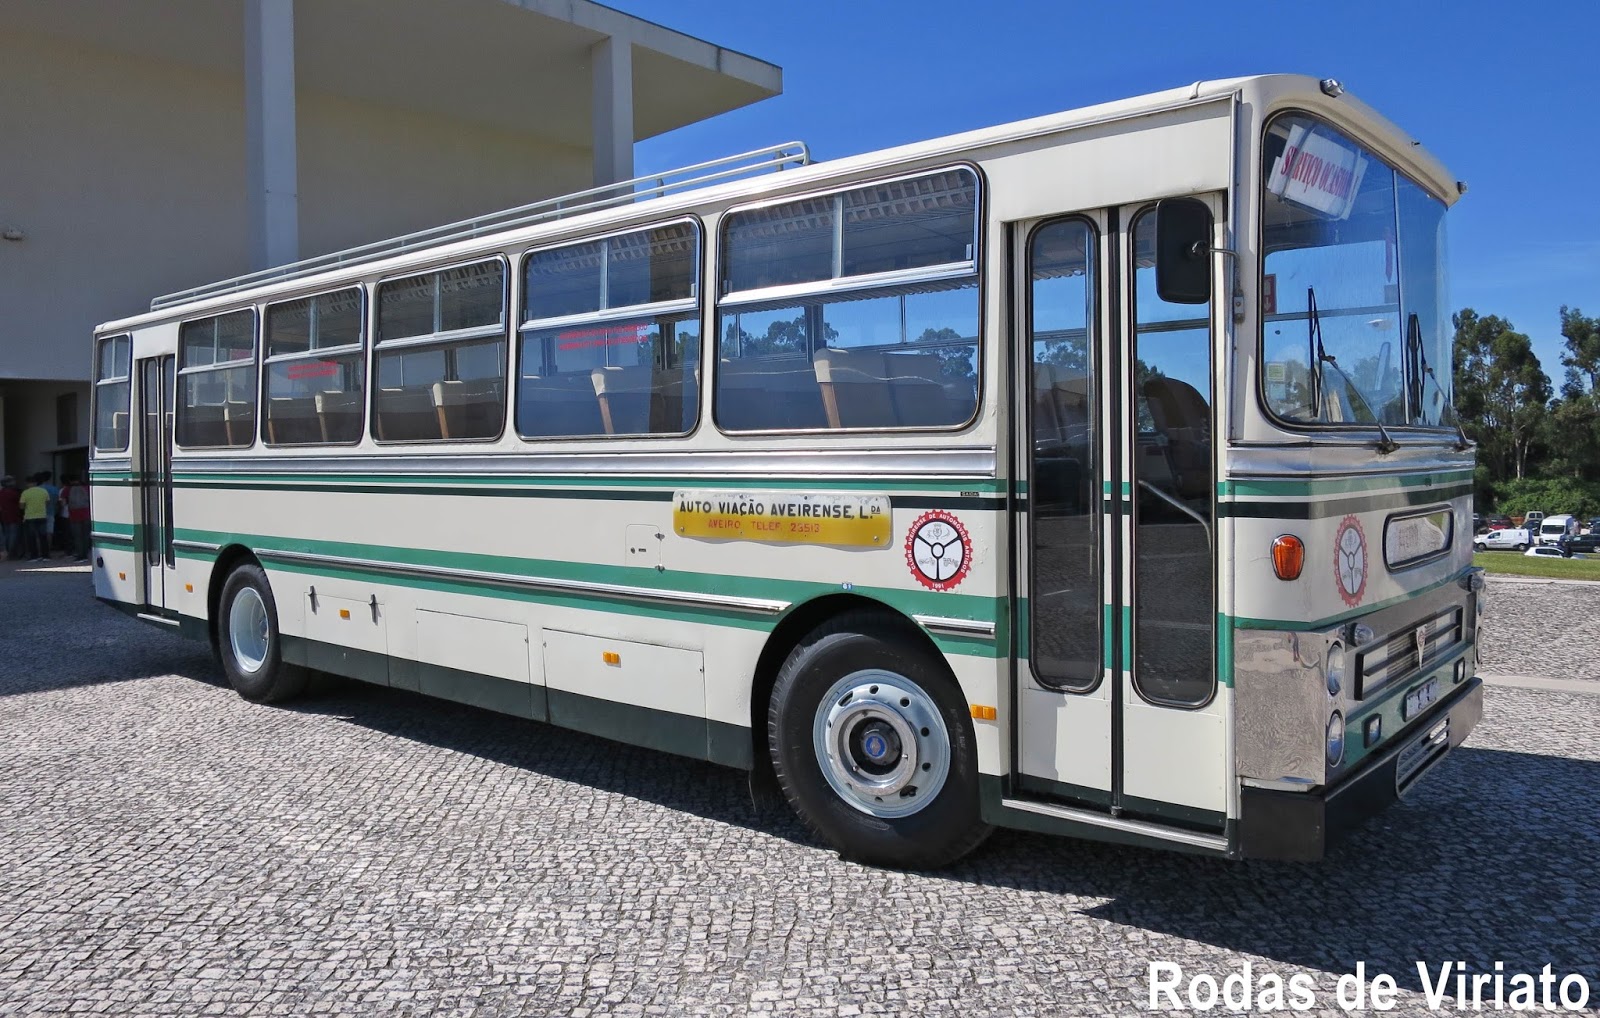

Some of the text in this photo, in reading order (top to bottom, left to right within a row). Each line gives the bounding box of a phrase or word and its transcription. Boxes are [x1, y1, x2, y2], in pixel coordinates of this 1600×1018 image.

[680, 501, 711, 513] AUTO
[719, 498, 764, 516] VIAÇÃO
[770, 503, 855, 520] AVEIRENSE,
[708, 519, 741, 529] AVEIRO
[908, 517, 926, 546] AVEIRENSE
[907, 549, 916, 570] CLUBE
[960, 545, 970, 574] ANTIGOS
